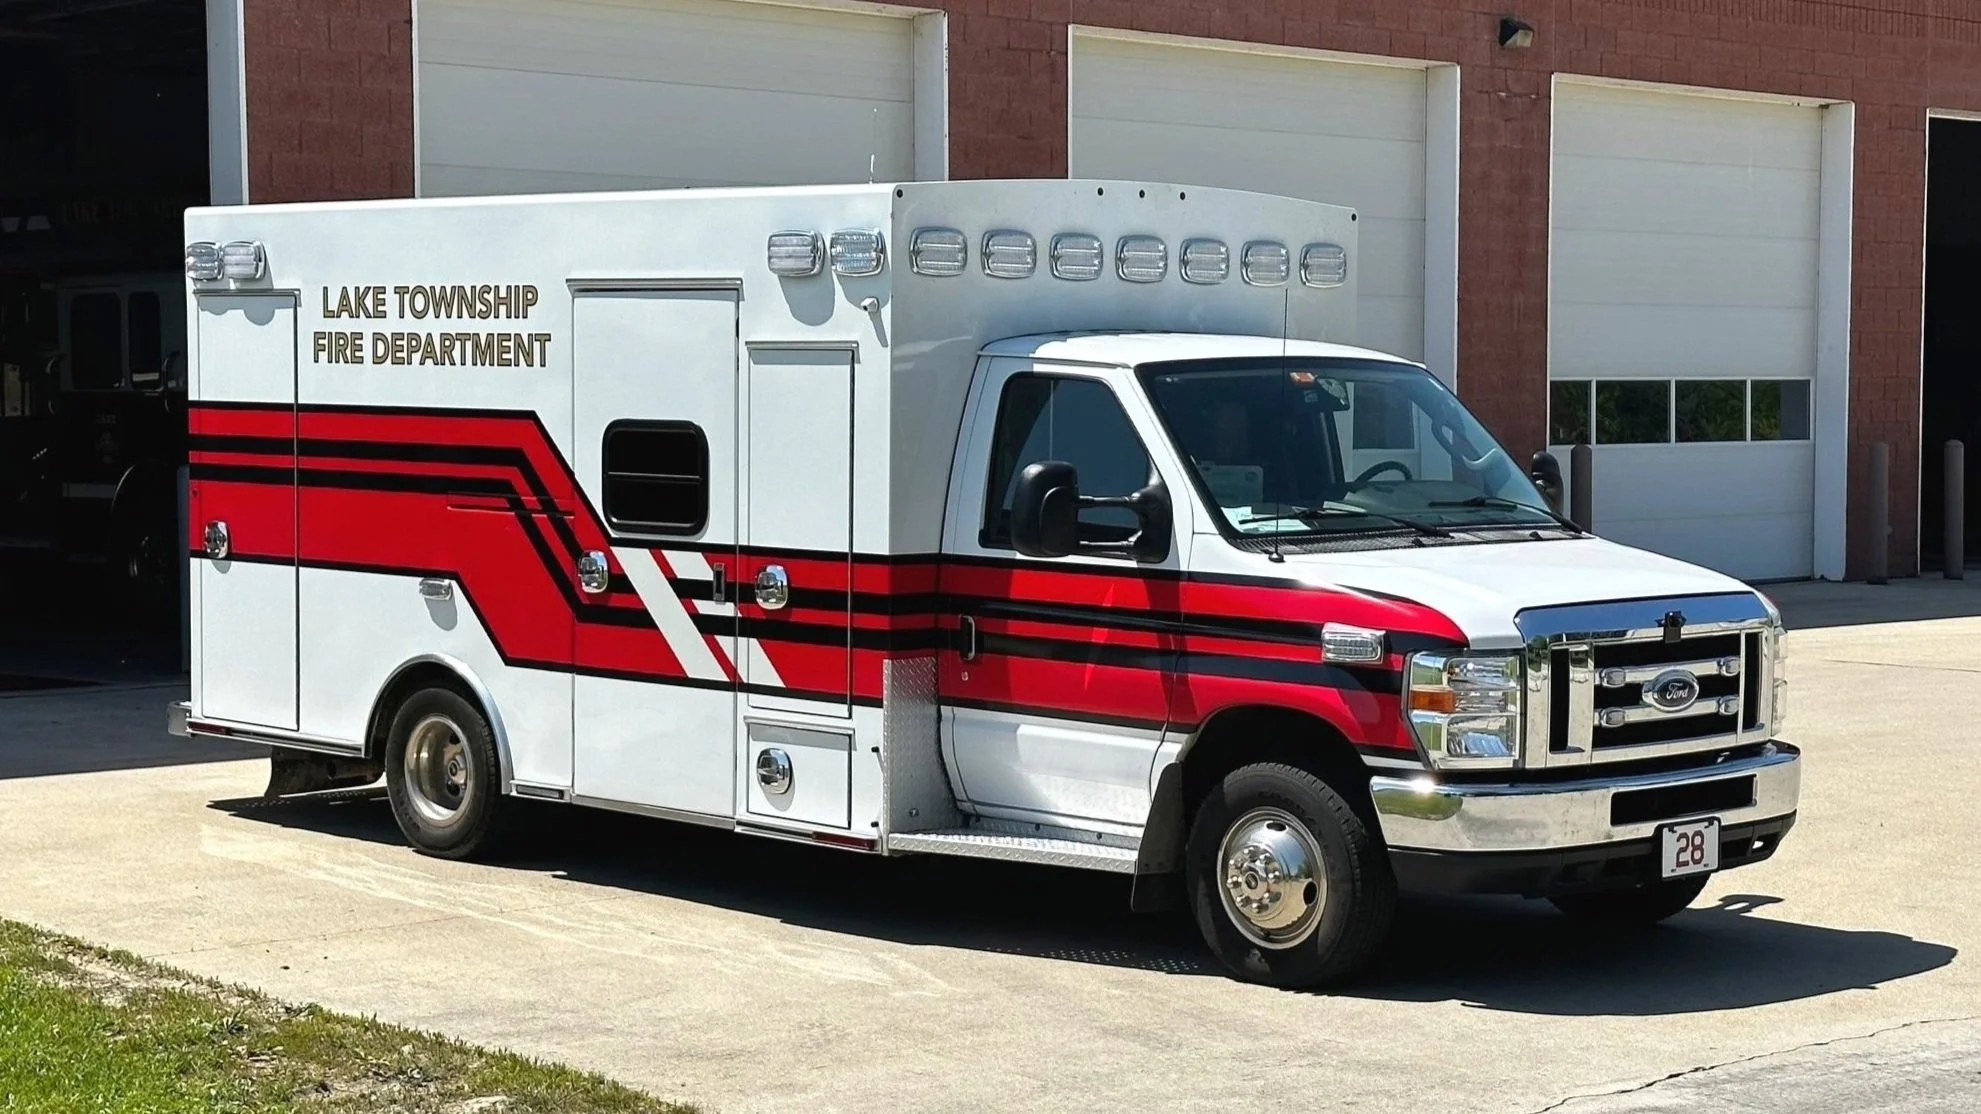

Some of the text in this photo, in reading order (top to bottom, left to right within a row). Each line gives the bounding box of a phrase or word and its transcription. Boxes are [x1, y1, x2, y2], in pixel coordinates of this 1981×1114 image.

[322, 284, 539, 320] LAKE TOWNSHIP
[313, 331, 552, 367] FIRE DEPARTMENT
[1666, 682, 1690, 700] Ford
[1675, 830, 1705, 868] 28
